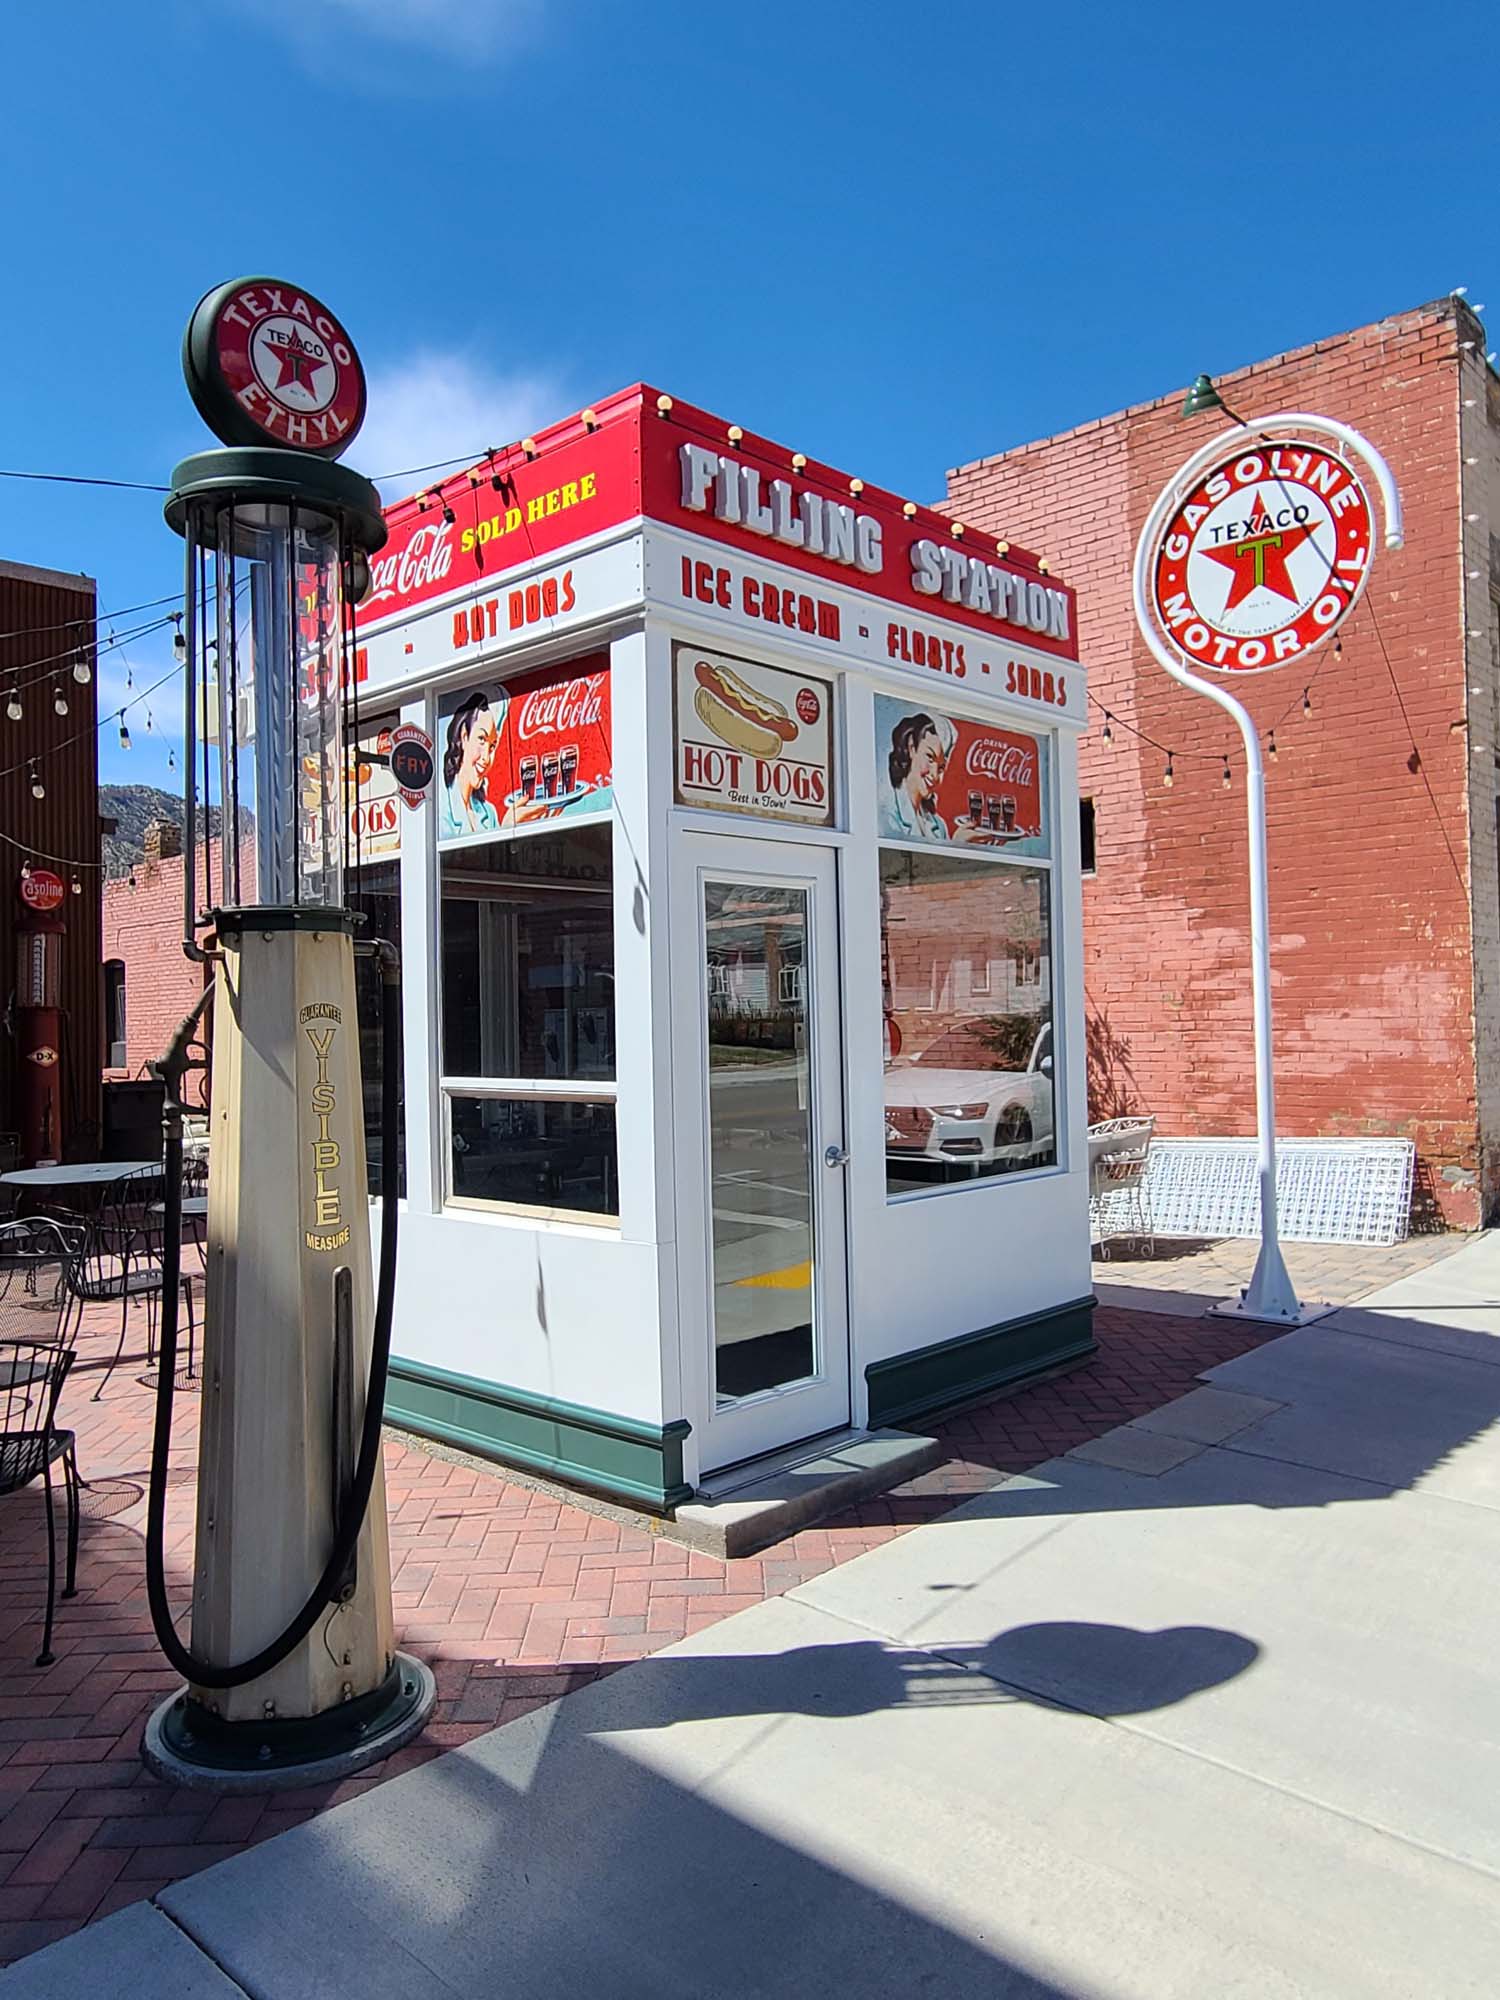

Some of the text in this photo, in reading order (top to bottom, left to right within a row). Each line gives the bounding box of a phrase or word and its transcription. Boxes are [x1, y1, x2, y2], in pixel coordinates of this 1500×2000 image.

[223, 288, 350, 366] TEXACO
[267, 329, 324, 358] TEXACO
[237, 382, 349, 443] ETHYL
[460, 473, 596, 552] SOLD HERE
[1165, 451, 1361, 561] GASOLINE
[1210, 505, 1310, 544] TEXACO
[356, 519, 453, 608] ca-Cola
[679, 443, 1069, 640] FILLING STATION
[1236, 535, 1282, 586] T
[453, 569, 576, 648] HOT DOGS
[681, 556, 1067, 707] ICE CREAM FLOATS SODAS
[1163, 547, 1366, 666] MOTOR OIL
[518, 673, 606, 741] Coca-Cola
[396, 754, 429, 775] FRY
[684, 746, 825, 803] HOT DOGS
[966, 739, 1034, 786] Coca-Cola
[728, 790, 749, 804] Best
[751, 795, 760, 805] in
[306, 1028, 341, 1227] VISIBLE
[306, 1225, 350, 1251] MEASURE
